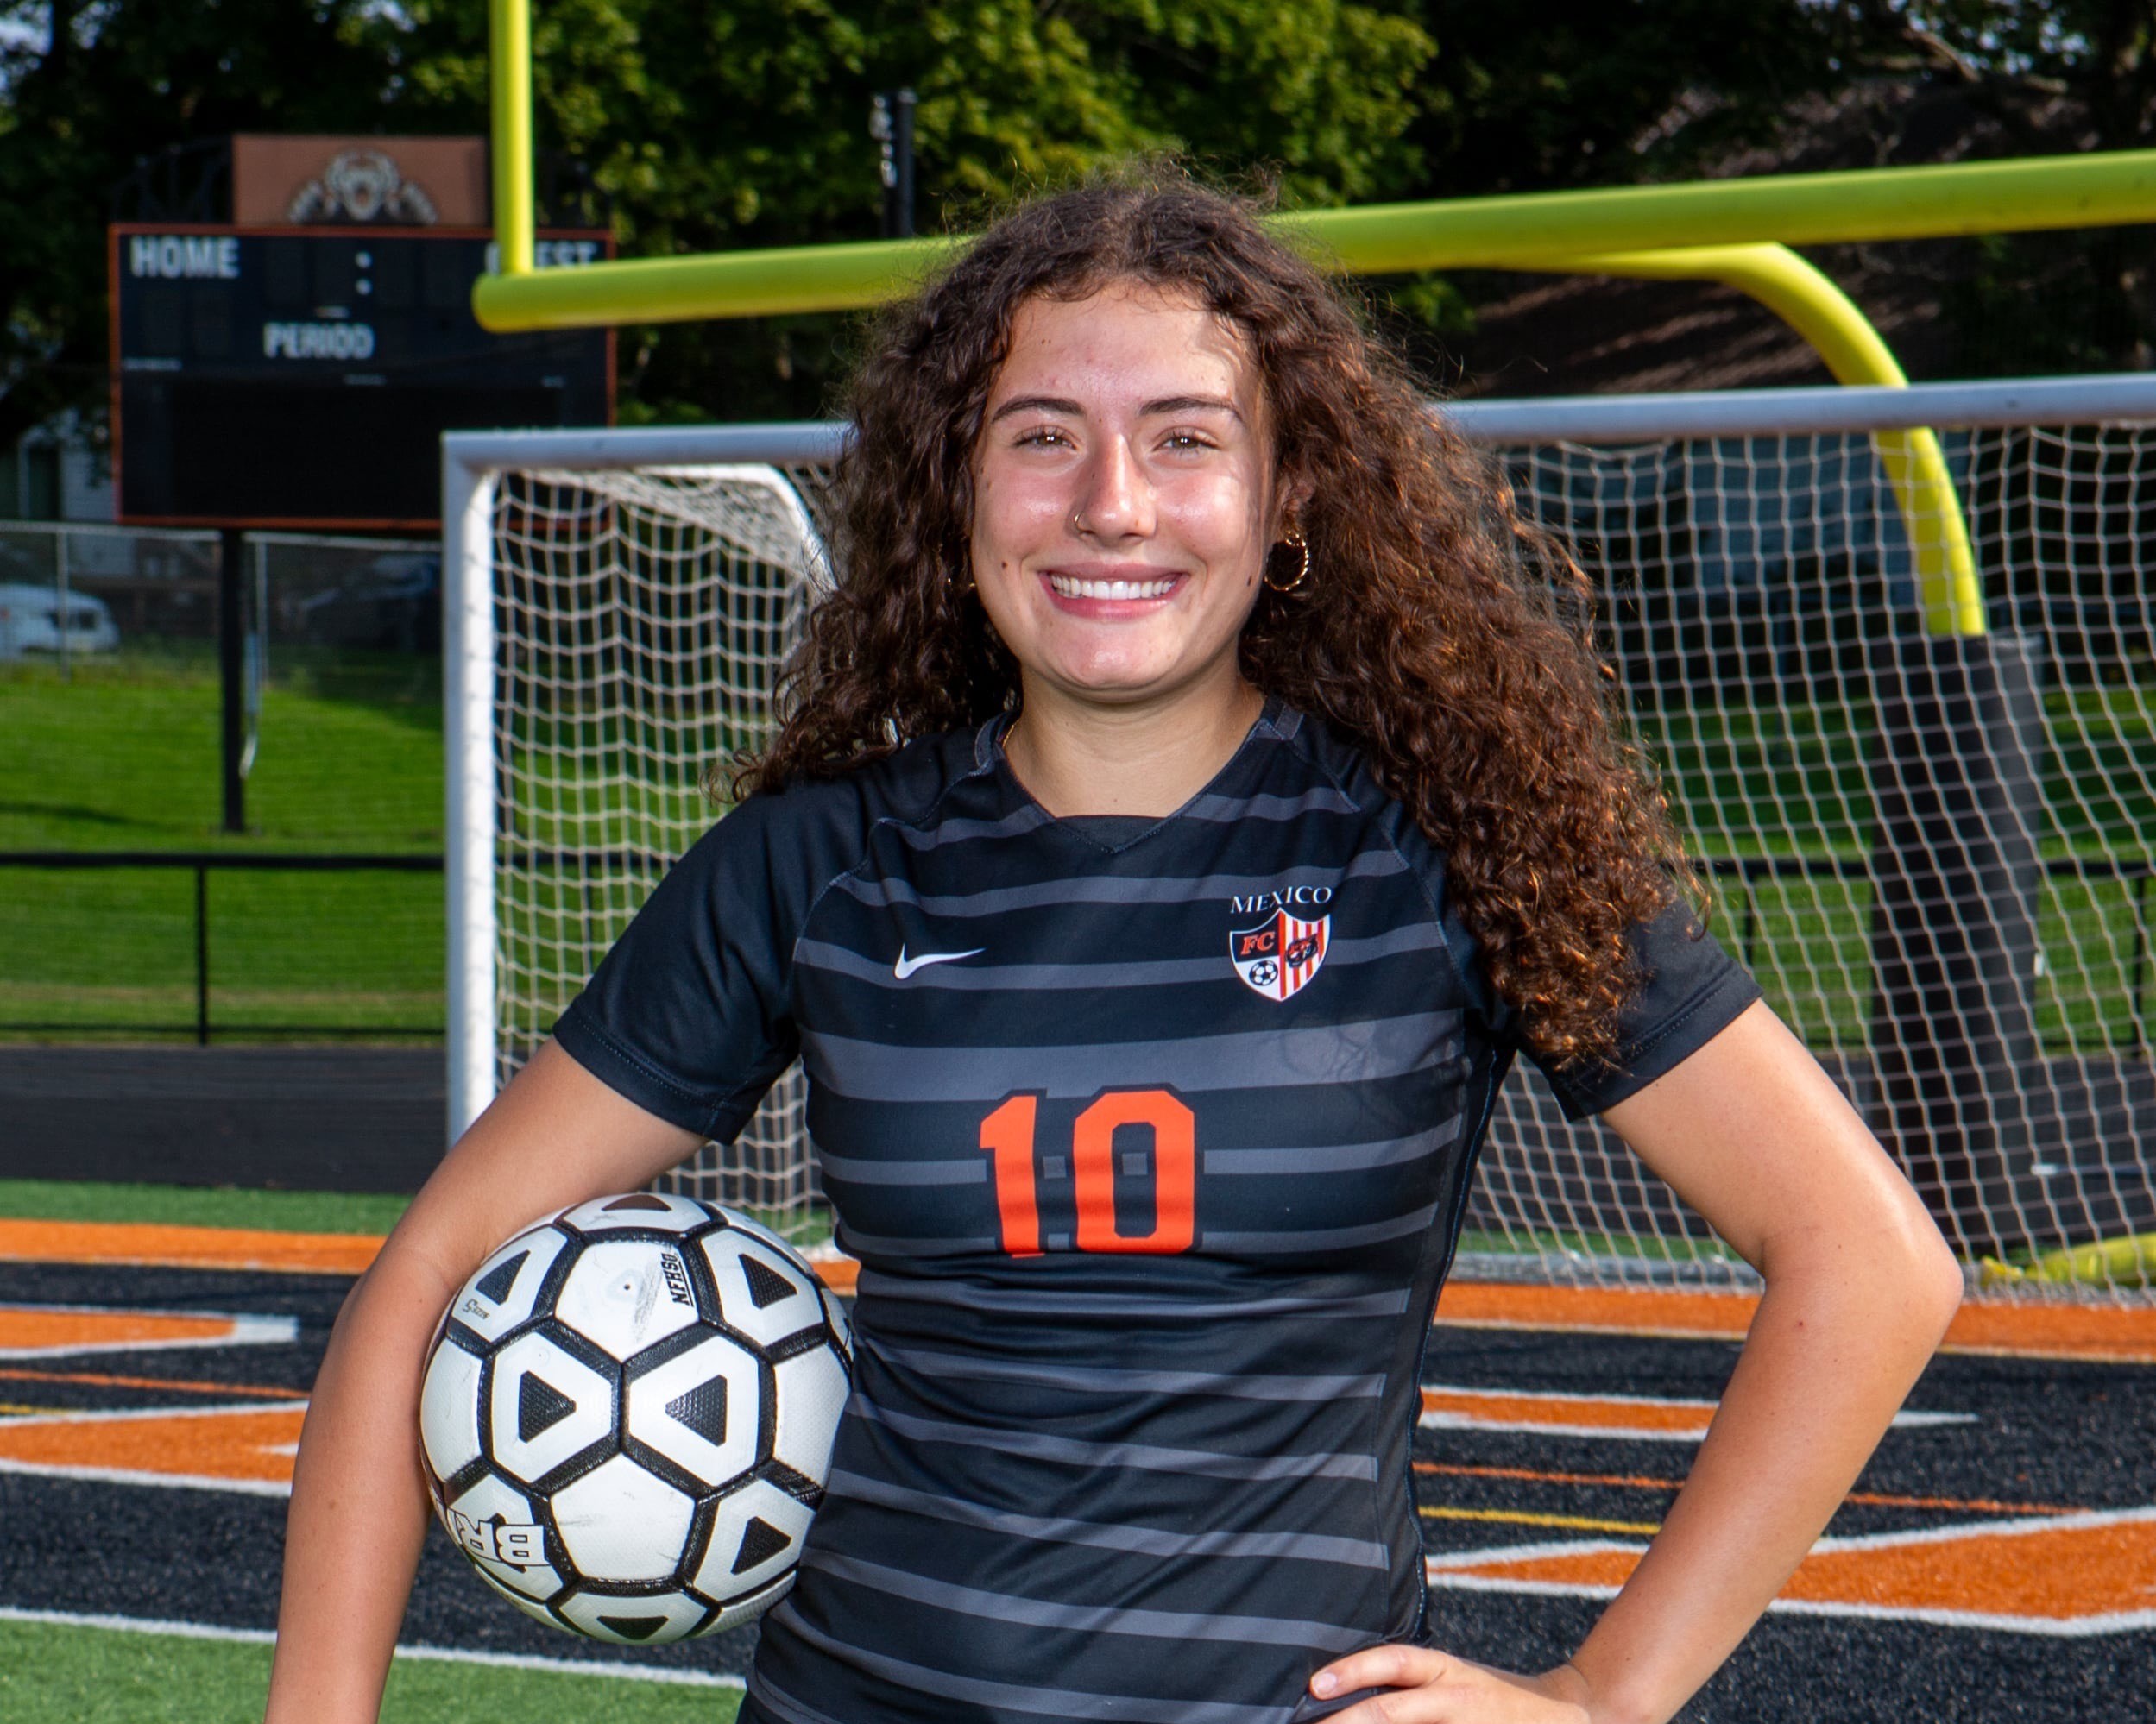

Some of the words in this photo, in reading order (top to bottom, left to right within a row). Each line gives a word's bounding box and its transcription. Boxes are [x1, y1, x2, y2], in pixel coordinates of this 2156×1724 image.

[130, 236, 240, 278] HOME
[485, 240, 597, 274] EST
[263, 322, 375, 359] PERIOD
[1230, 885, 1333, 914] MEXICO
[1240, 931, 1276, 956] FC
[979, 1087, 1196, 1258] 10
